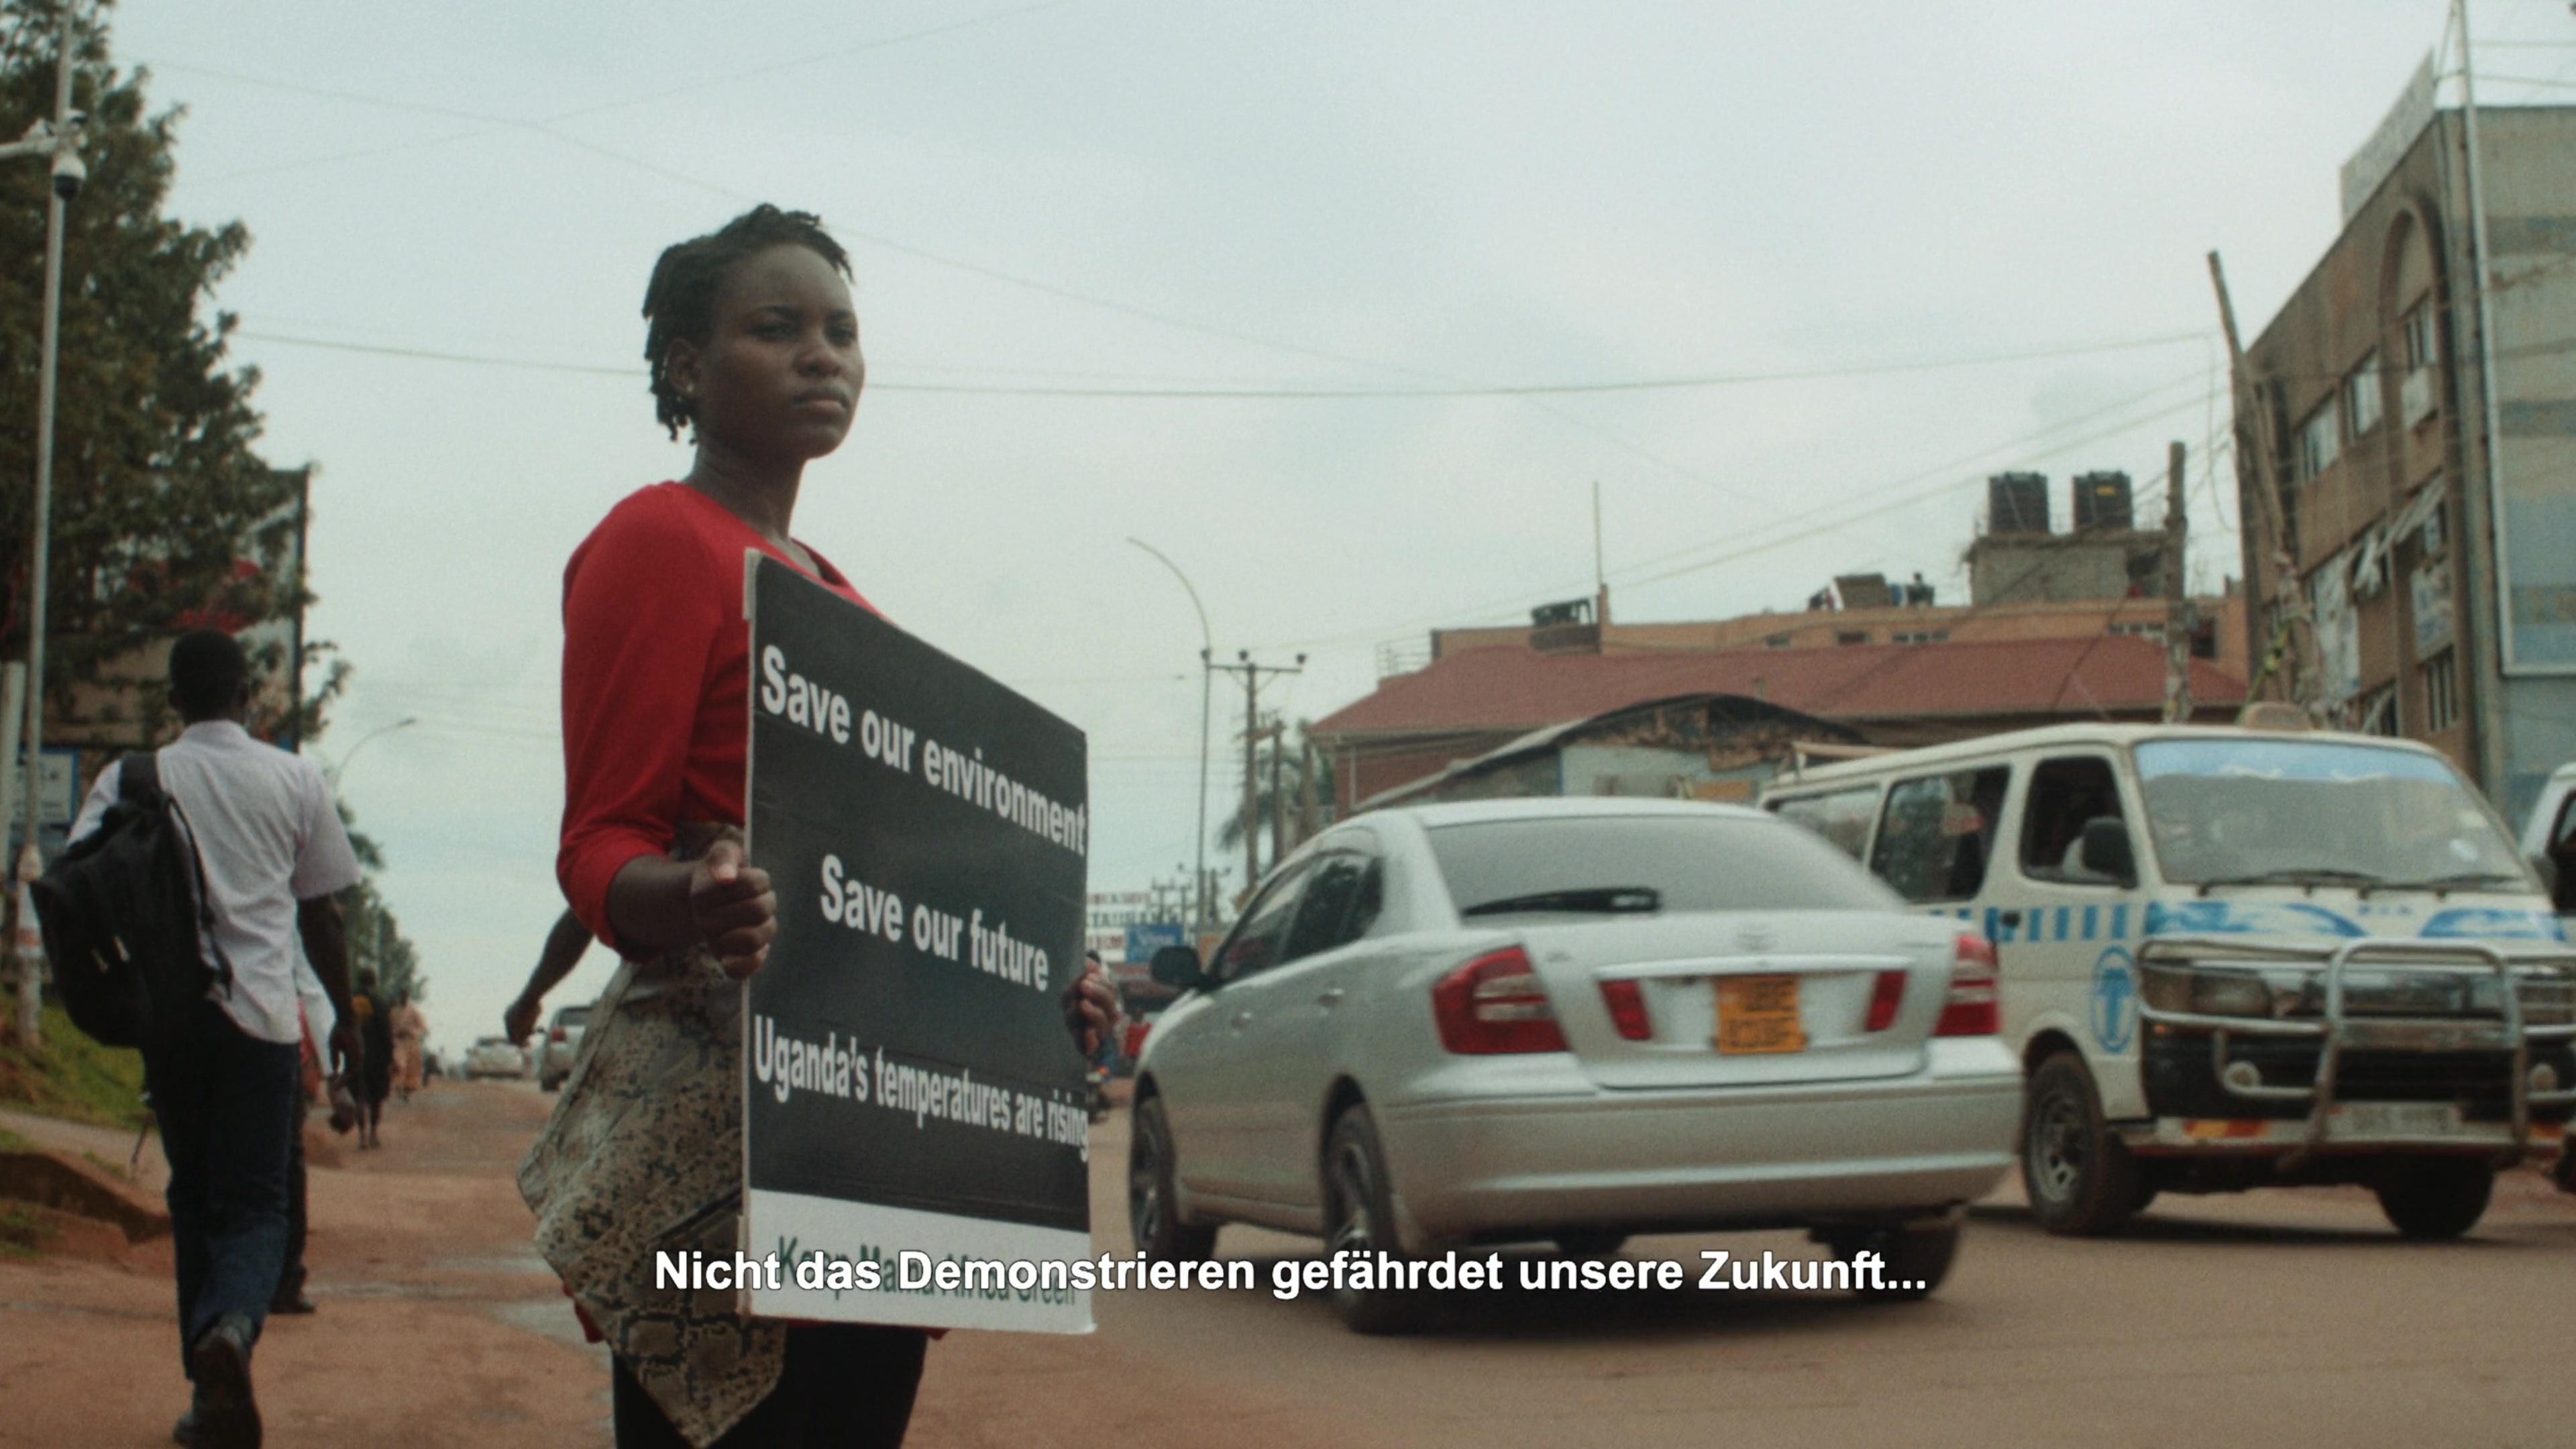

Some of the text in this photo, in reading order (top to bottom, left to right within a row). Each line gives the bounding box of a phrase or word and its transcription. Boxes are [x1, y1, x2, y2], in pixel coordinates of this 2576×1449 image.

[761, 645, 1086, 856] Save our environment
[820, 853, 1049, 991] Save our future
[755, 1014, 1089, 1162] Uganda's temperatures are rising
